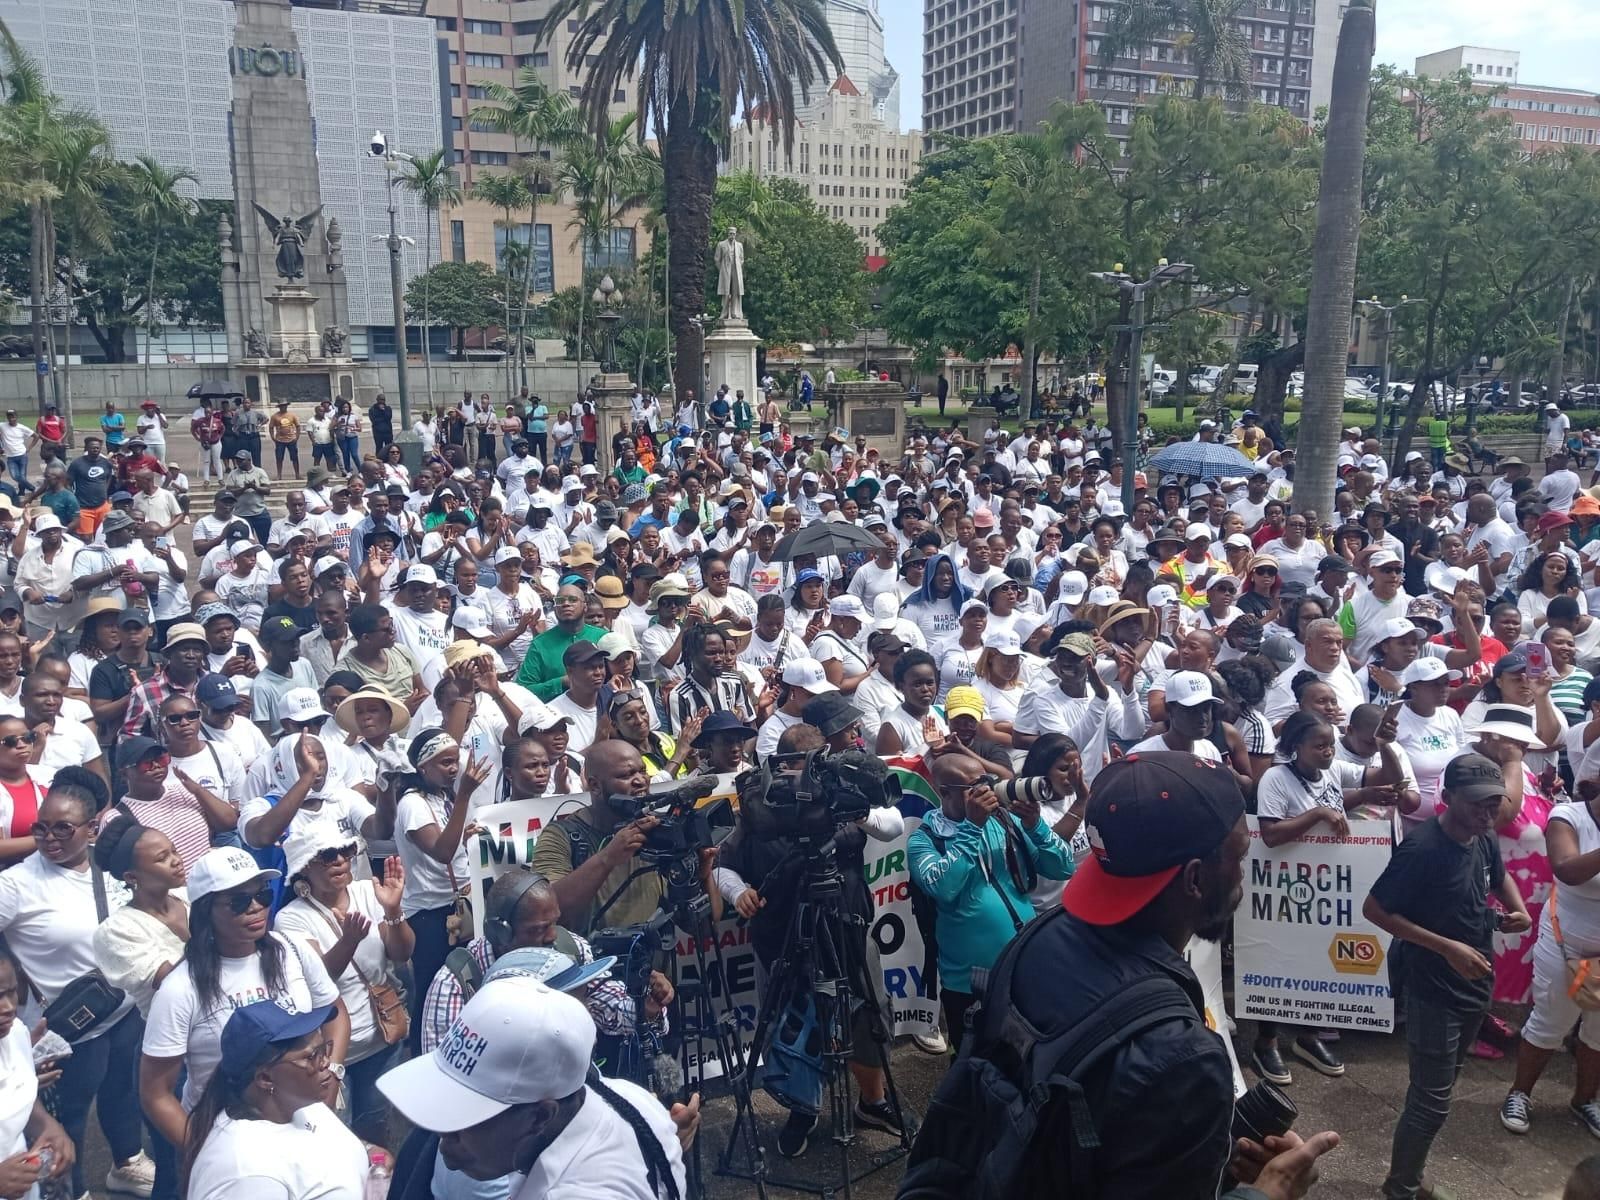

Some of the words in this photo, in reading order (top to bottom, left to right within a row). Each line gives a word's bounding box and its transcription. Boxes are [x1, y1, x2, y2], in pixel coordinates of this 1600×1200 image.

[934, 622, 960, 631] MARCH
[864, 848, 906, 885] UR
[1252, 858, 1352, 893] MARCH
[1295, 886, 1307, 899] IN
[1252, 892, 1352, 927] MARCH
[1243, 973, 1393, 998] #DOIT4YOURCOUNTRY
[1246, 995, 1266, 1003] JOIN
[1268, 998, 1280, 1006] US
[1283, 999, 1292, 1007] IN
[1295, 1000, 1336, 1011] FIGHTING
[1338, 1004, 1376, 1014] ILLEGAL
[894, 1009, 934, 1025] RIMES
[1246, 1006, 1301, 1020] IMMIGRANTS
[1303, 1012, 1323, 1022] AND
[1325, 1014, 1353, 1024] THEIR
[1355, 1017, 1390, 1028] CRIMES
